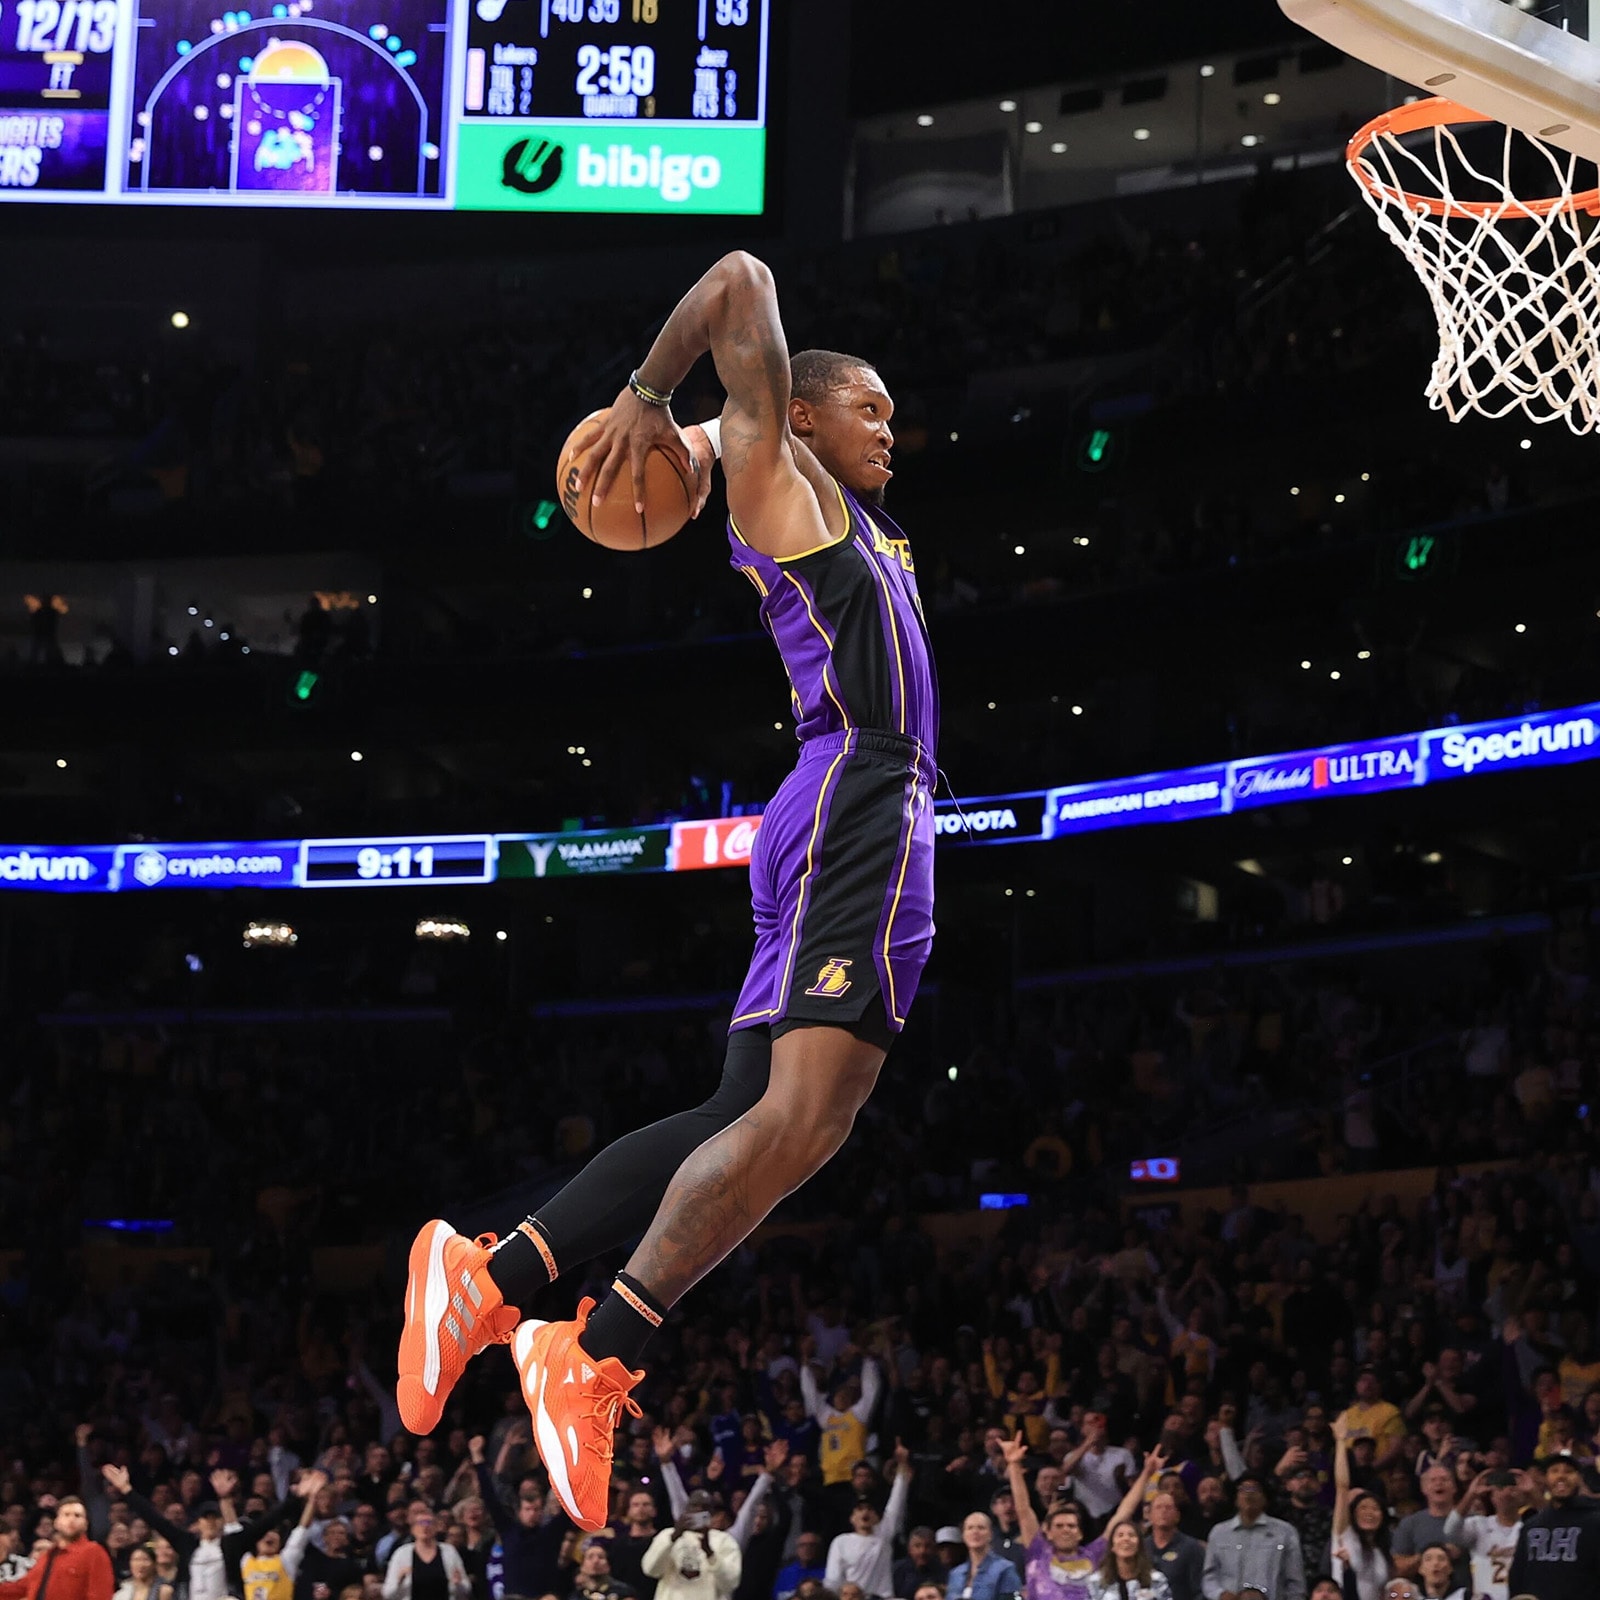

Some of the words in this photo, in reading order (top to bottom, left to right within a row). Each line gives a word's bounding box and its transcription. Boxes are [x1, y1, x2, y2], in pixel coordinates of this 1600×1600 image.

[16, 0, 117, 53] 12/13
[576, 45, 655, 96] 2:59
[577, 144, 721, 202] bibigo
[1442, 718, 1595, 773] Spectrum
[1330, 749, 1413, 783] ULTRA
[1059, 793, 1143, 821] AMERICAN
[1143, 781, 1219, 808] EXPRESS
[934, 809, 1017, 835] TOYOTA
[167, 855, 282, 878] crypto.com
[357, 846, 434, 878] 9:11
